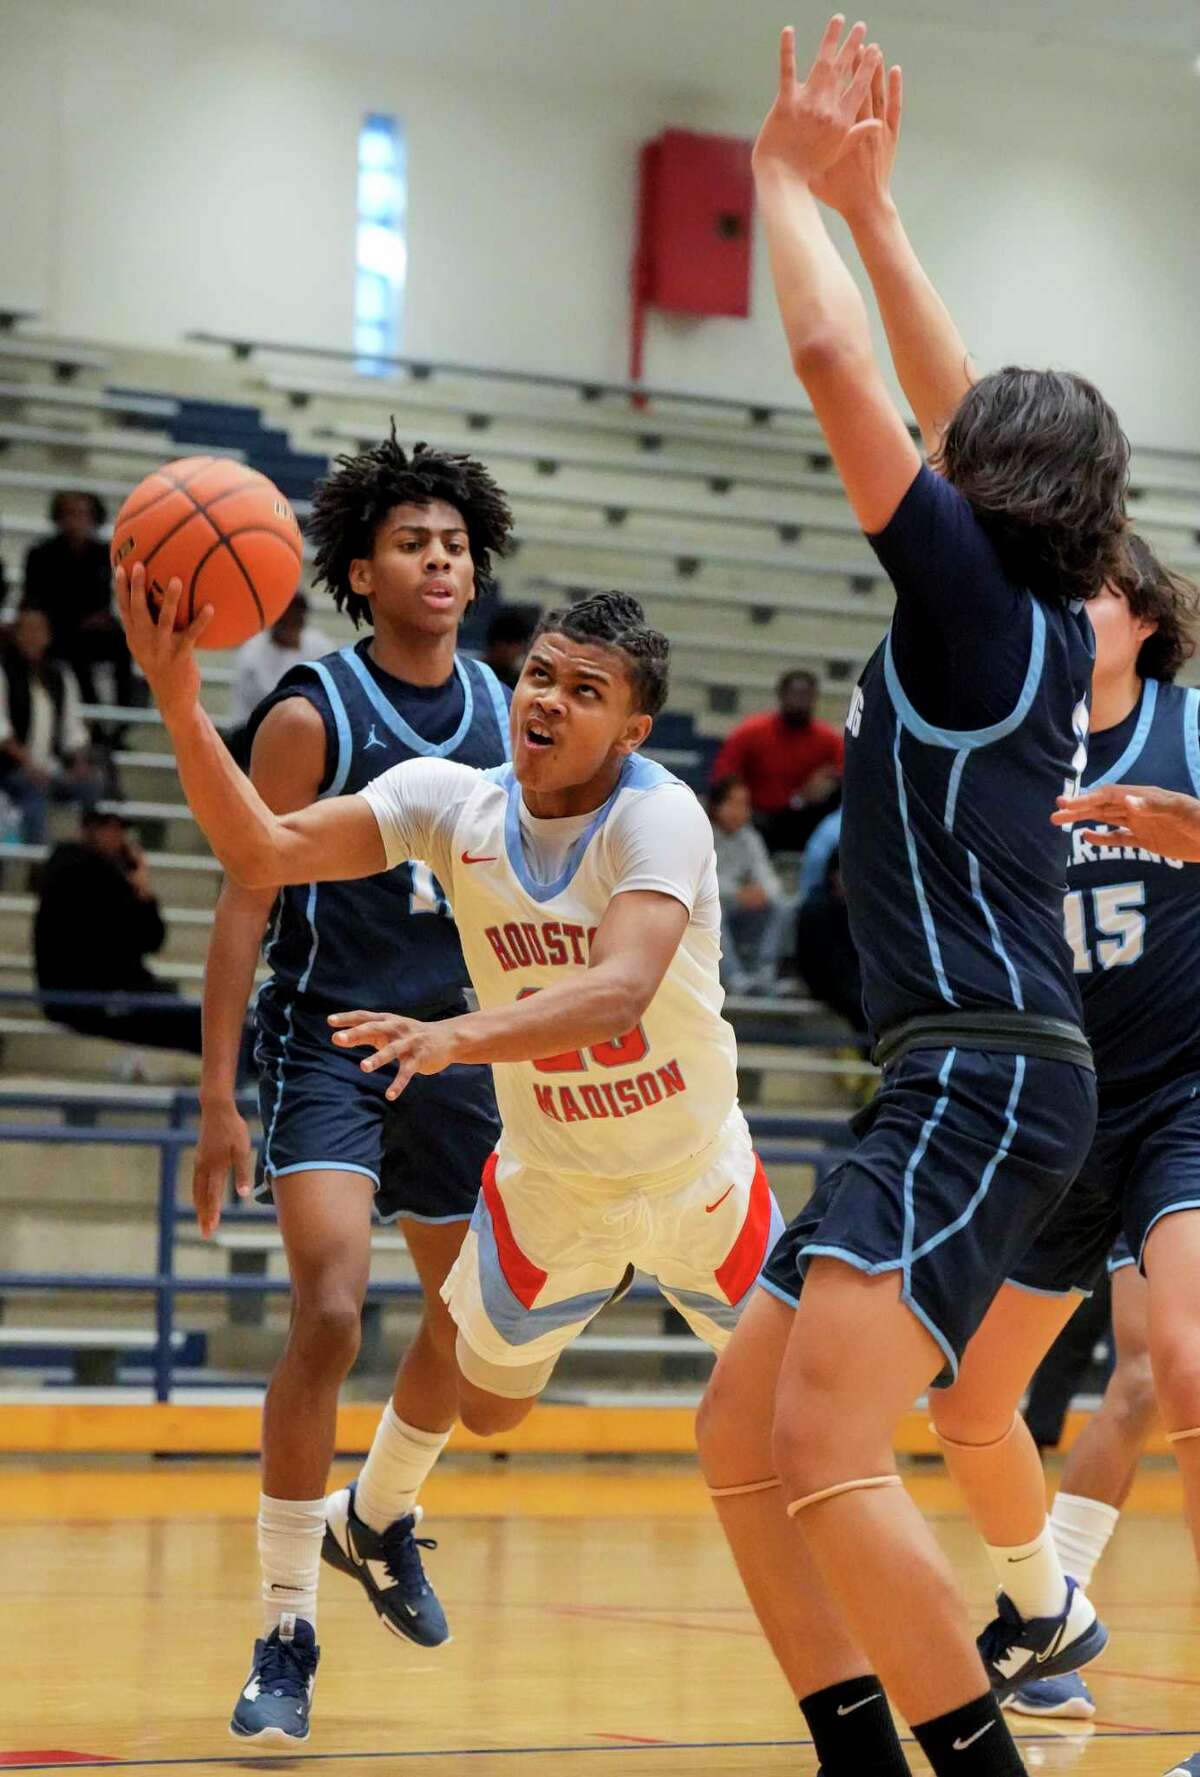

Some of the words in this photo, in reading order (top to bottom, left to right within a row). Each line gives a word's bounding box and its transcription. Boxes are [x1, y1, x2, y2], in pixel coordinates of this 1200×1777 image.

[484, 921, 599, 972] HOUST
[1062, 881, 1145, 974] 15
[532, 1058, 687, 1123] MADISON
